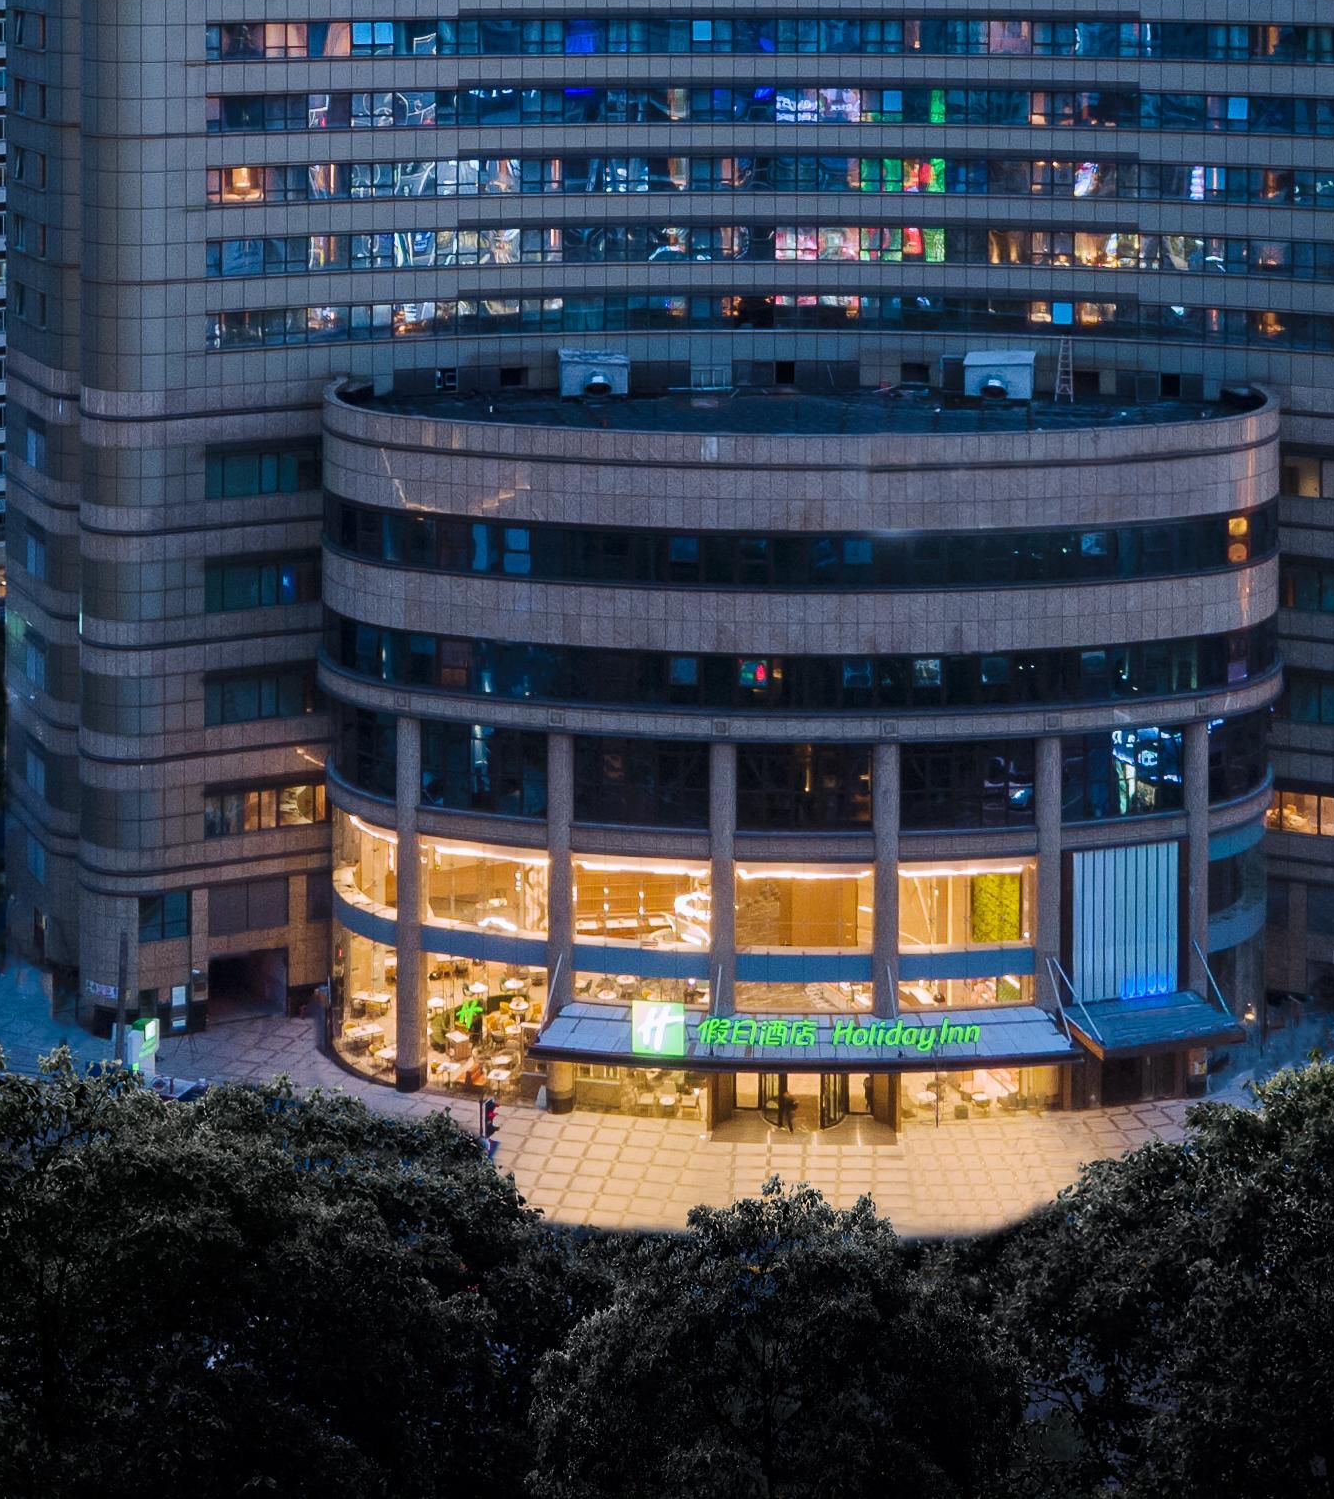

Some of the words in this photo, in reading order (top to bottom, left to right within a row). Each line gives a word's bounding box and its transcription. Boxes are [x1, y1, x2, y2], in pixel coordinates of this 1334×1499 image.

[697, 1018, 817, 1046] 假日酒店
[832, 1018, 937, 1051] Holiday
[940, 1017, 981, 1045] Inn
